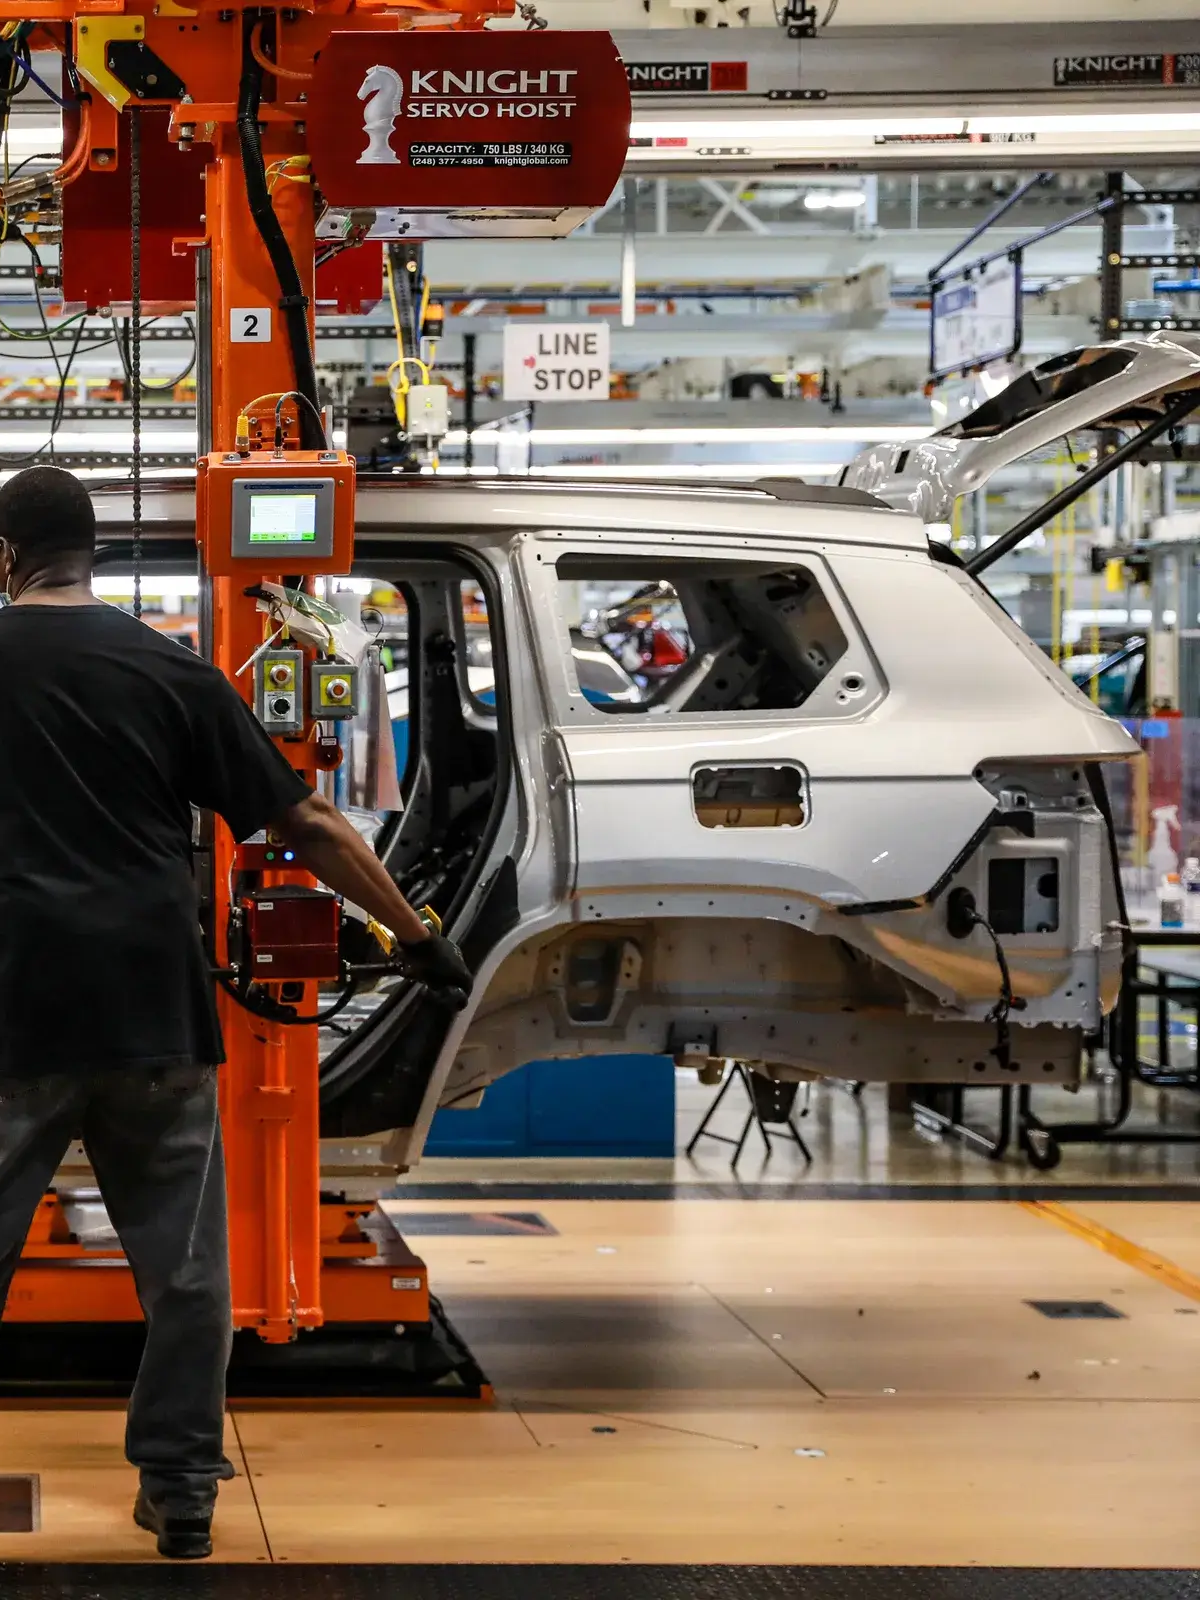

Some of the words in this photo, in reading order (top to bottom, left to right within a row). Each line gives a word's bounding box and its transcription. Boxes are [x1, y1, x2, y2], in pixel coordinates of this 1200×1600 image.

[1068, 56, 1160, 71] KNIGHT
[411, 70, 578, 93] KNIGHT
[407, 103, 489, 118] SERVO
[497, 103, 577, 118] HOIST
[410, 145, 476, 154] CAPACITY:
[483, 144, 499, 154] 750
[502, 144, 522, 154] LBS
[530, 144, 547, 154] 340
[550, 144, 565, 154] KG
[412, 157, 436, 166] (248)
[494, 157, 569, 166] knightglobal.com
[243, 314, 258, 337] 2
[538, 333, 598, 355] LINE
[534, 369, 603, 391] STOP
